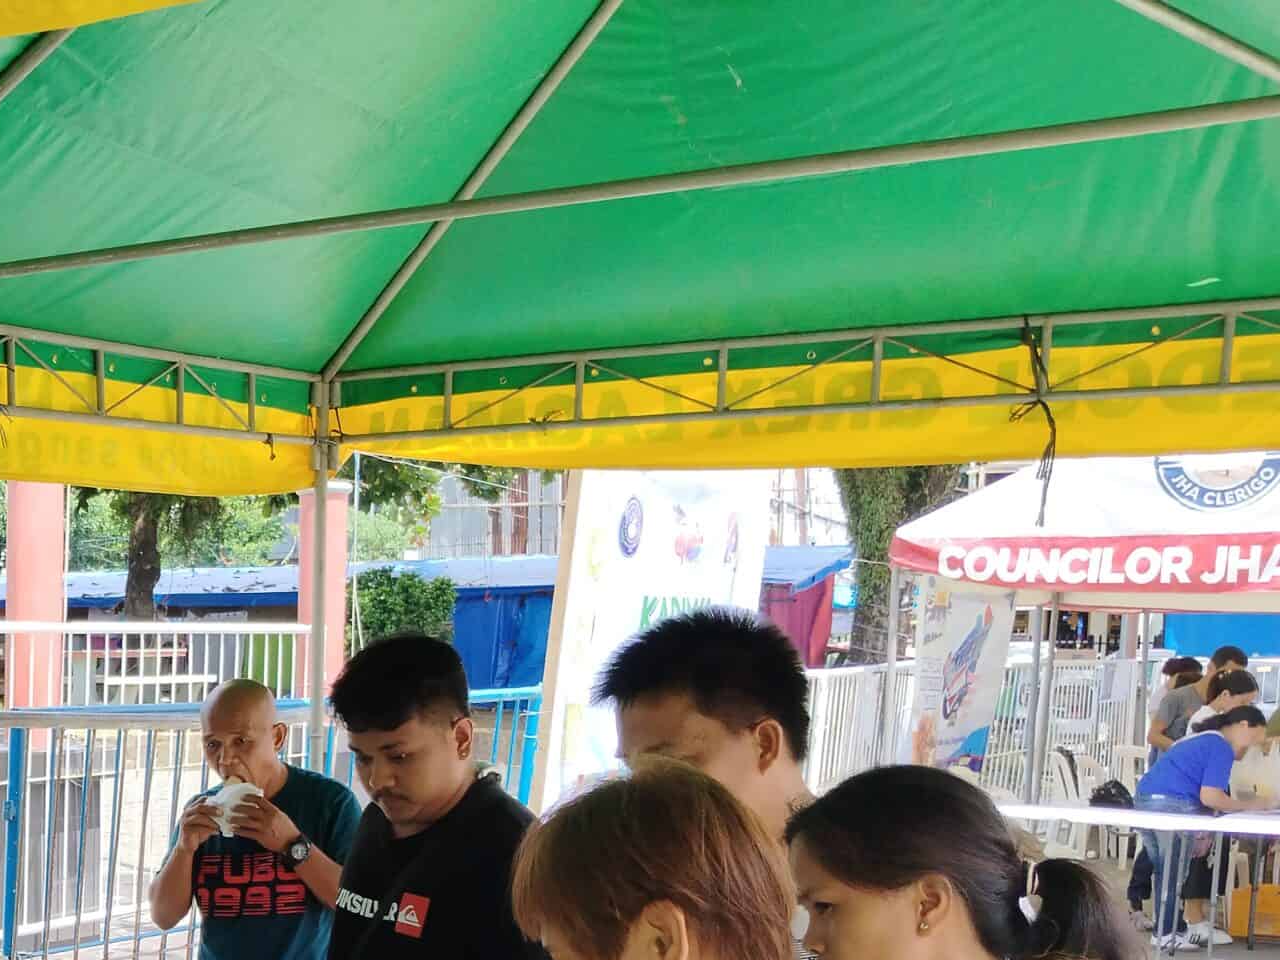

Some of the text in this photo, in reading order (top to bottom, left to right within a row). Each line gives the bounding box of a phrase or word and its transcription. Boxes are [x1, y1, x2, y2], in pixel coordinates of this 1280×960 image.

[1171, 465, 1276, 508] JHA CLERIGO
[937, 544, 1194, 585] COUNCILOR
[196, 884, 306, 918] 1992
